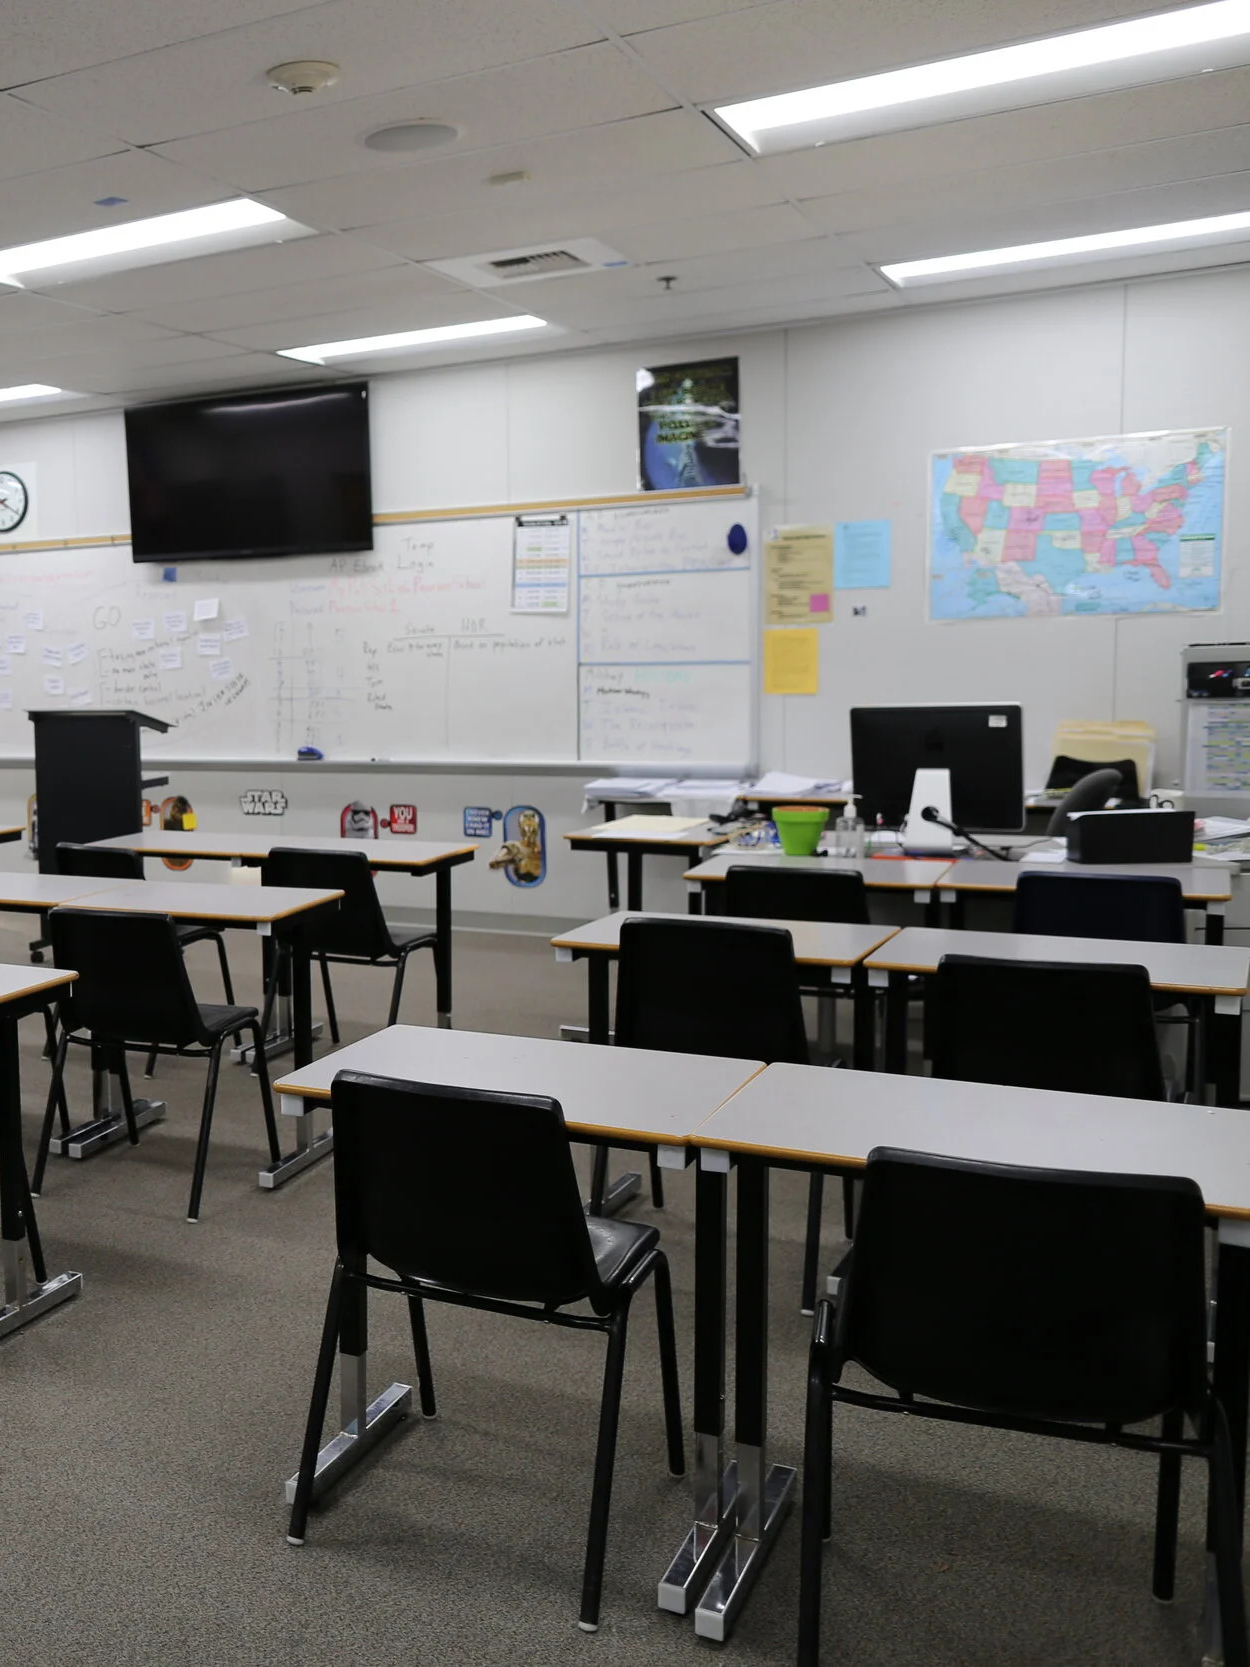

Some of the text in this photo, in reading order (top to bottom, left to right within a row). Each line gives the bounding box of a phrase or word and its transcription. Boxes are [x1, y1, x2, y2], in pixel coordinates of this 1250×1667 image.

[246, 790, 283, 803] STAR
[240, 797, 287, 815] WARS
[392, 806, 413, 821] YOU
